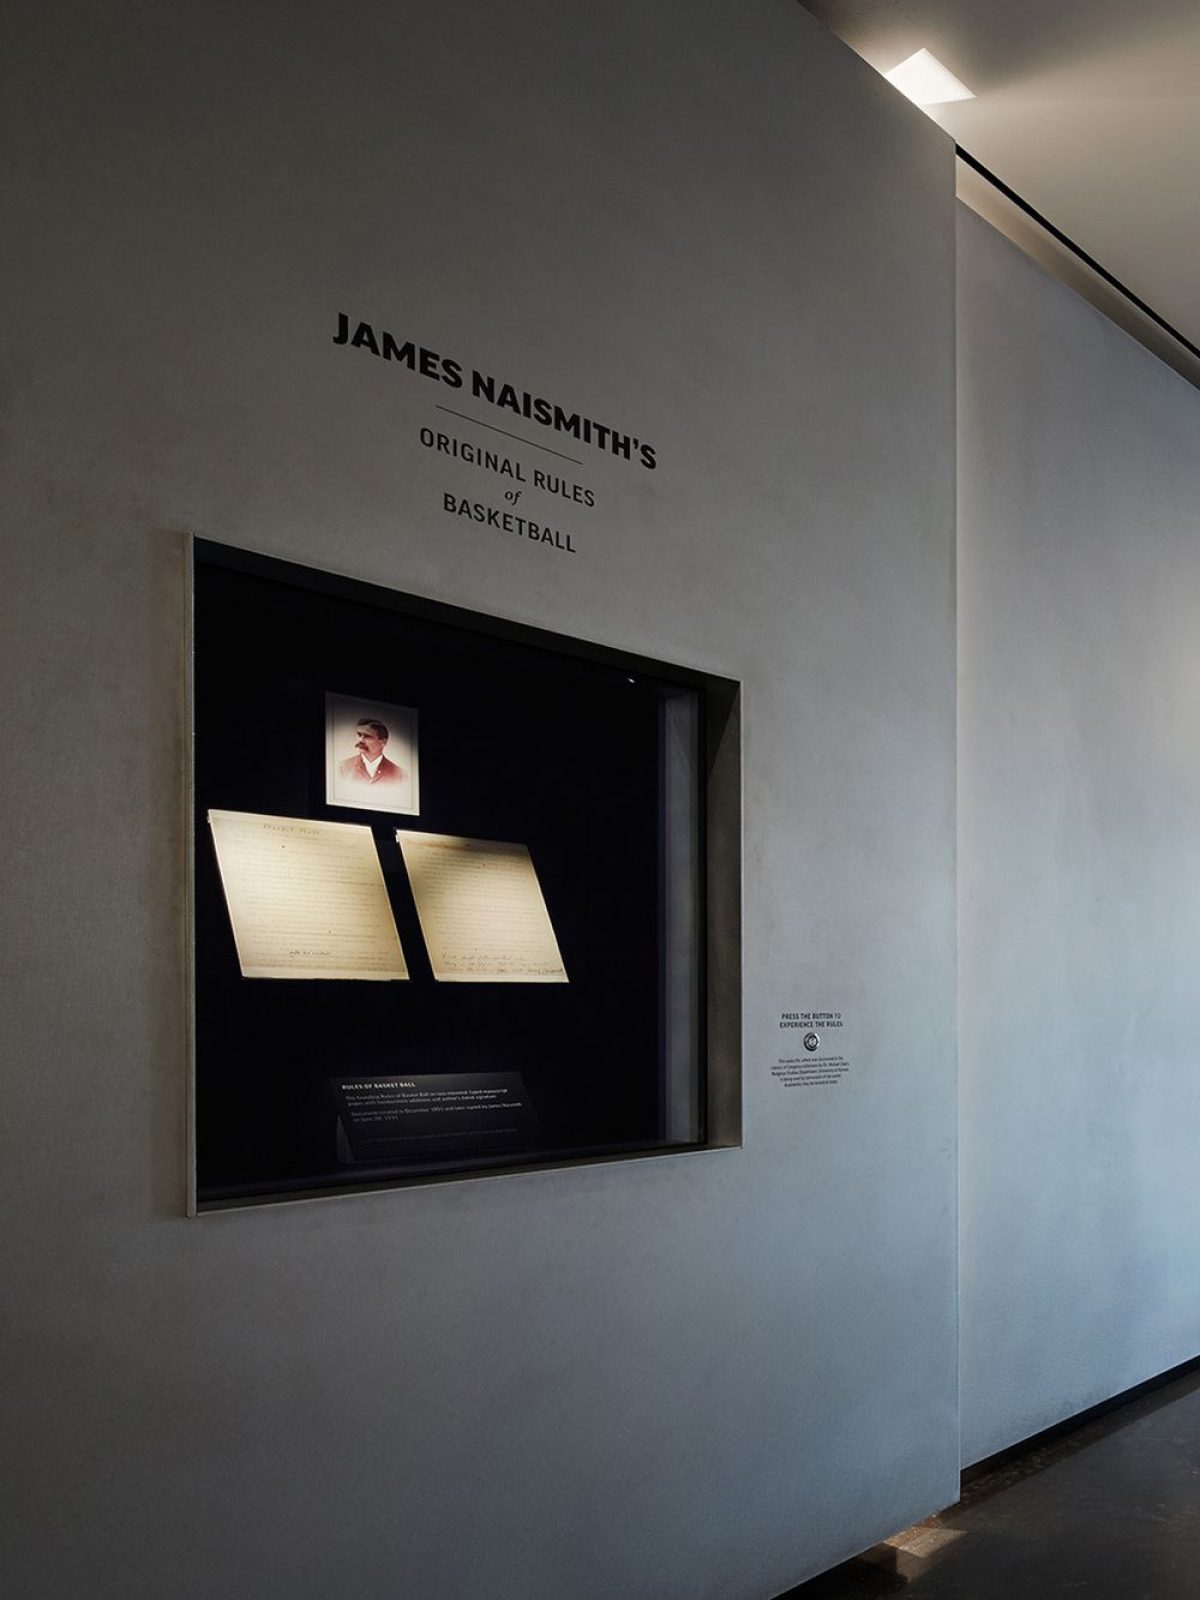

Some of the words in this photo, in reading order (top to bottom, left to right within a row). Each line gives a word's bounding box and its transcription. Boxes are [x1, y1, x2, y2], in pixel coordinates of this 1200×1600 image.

[333, 312, 463, 388] JAMES
[472, 370, 657, 470] NAISMITH'S
[420, 427, 526, 482] ORIGINAL
[534, 469, 595, 507] RULES
[504, 489, 522, 505] of
[443, 493, 576, 553] BASKETBALL
